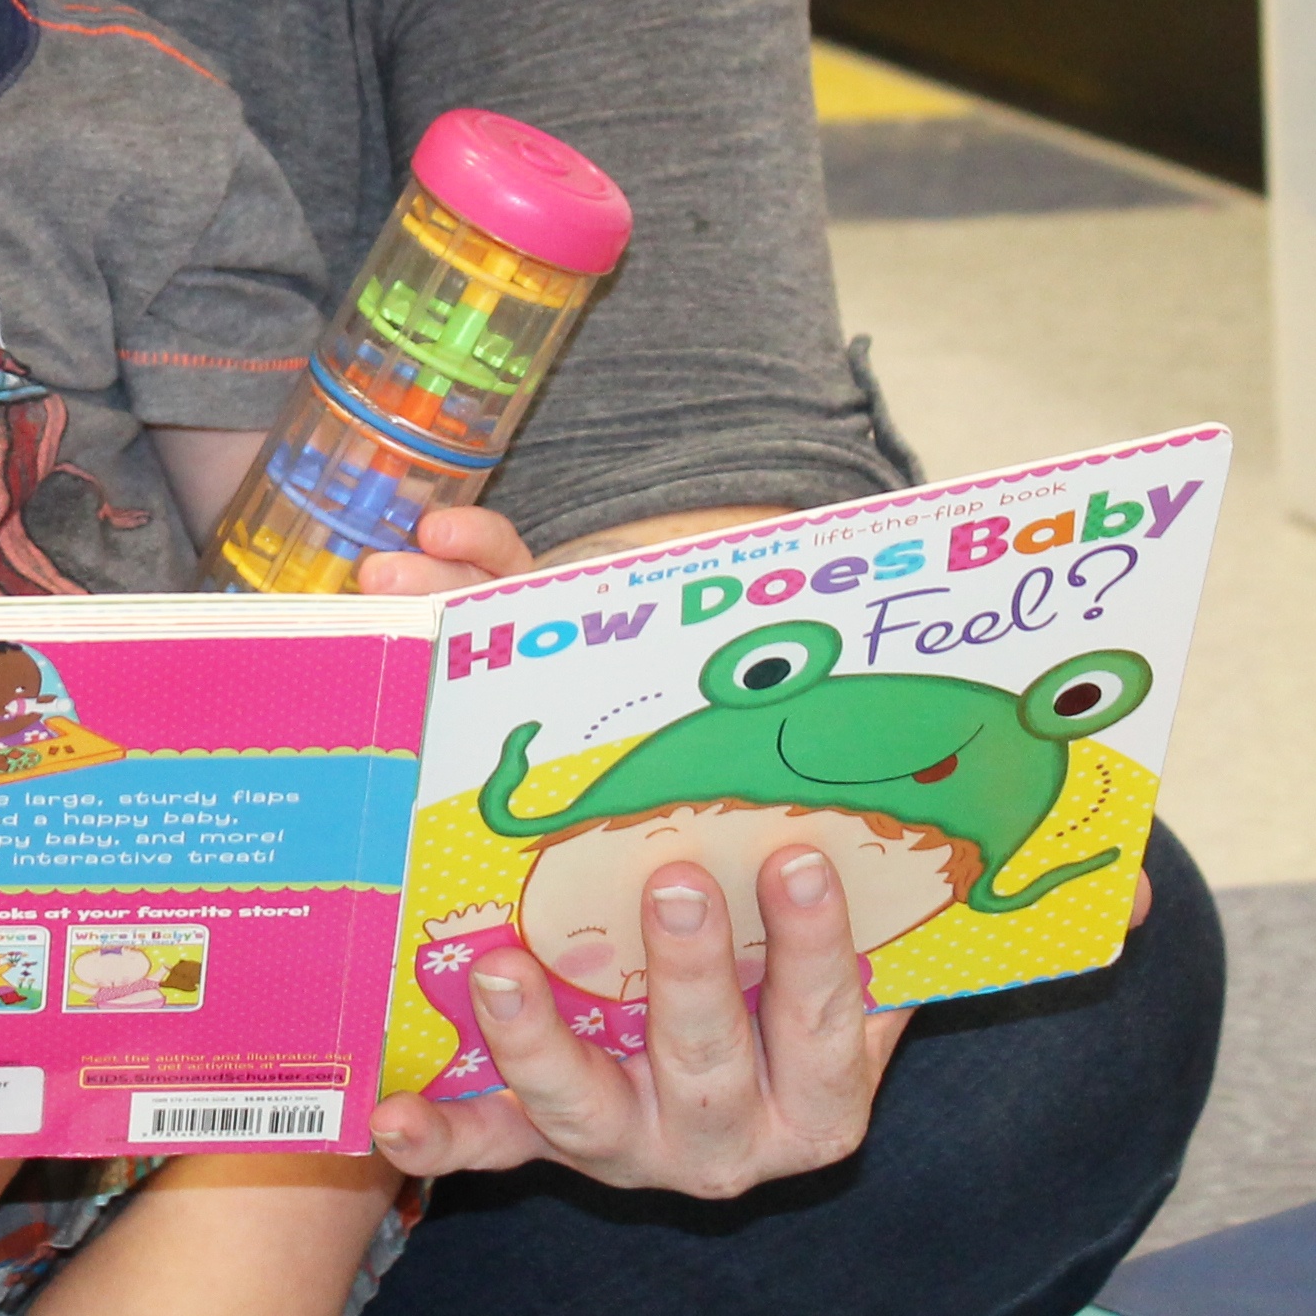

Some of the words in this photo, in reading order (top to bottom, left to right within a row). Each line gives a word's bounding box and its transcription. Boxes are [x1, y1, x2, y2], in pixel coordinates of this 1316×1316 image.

[596, 583, 610, 595] a
[628, 558, 719, 587] karen
[731, 538, 800, 565] katz
[813, 500, 984, 546] lift-the-flap
[999, 482, 1067, 506] book
[447, 602, 658, 681] How
[680, 539, 926, 626] Does
[947, 480, 1204, 573] Baby
[863, 543, 1139, 666] Feel?
[26, 792, 103, 808] large,
[119, 791, 217, 807] sturdy
[233, 790, 300, 806] flaps
[34, 814, 47, 826] a
[64, 812, 148, 828] happy
[164, 811, 238, 827] baby,
[136, 830, 185, 845] and
[200, 829, 284, 843] more!
[13, 851, 172, 866] interactive
[188, 849, 275, 864] treat!
[44, 907, 71, 920] at
[78, 907, 131, 921] your
[137, 905, 232, 919] favorite
[238, 905, 310, 918] store!
[75, 930, 127, 941] Where
[81, 1055, 117, 1063] Meet
[125, 1054, 149, 1062] the
[156, 1054, 205, 1062] author
[213, 1053, 240, 1061] and
[247, 1053, 318, 1061] illustrator
[325, 1052, 352, 1061] and
[158, 1063, 181, 1072] get
[188, 1062, 253, 1071] activities
[260, 1062, 274, 1070] at
